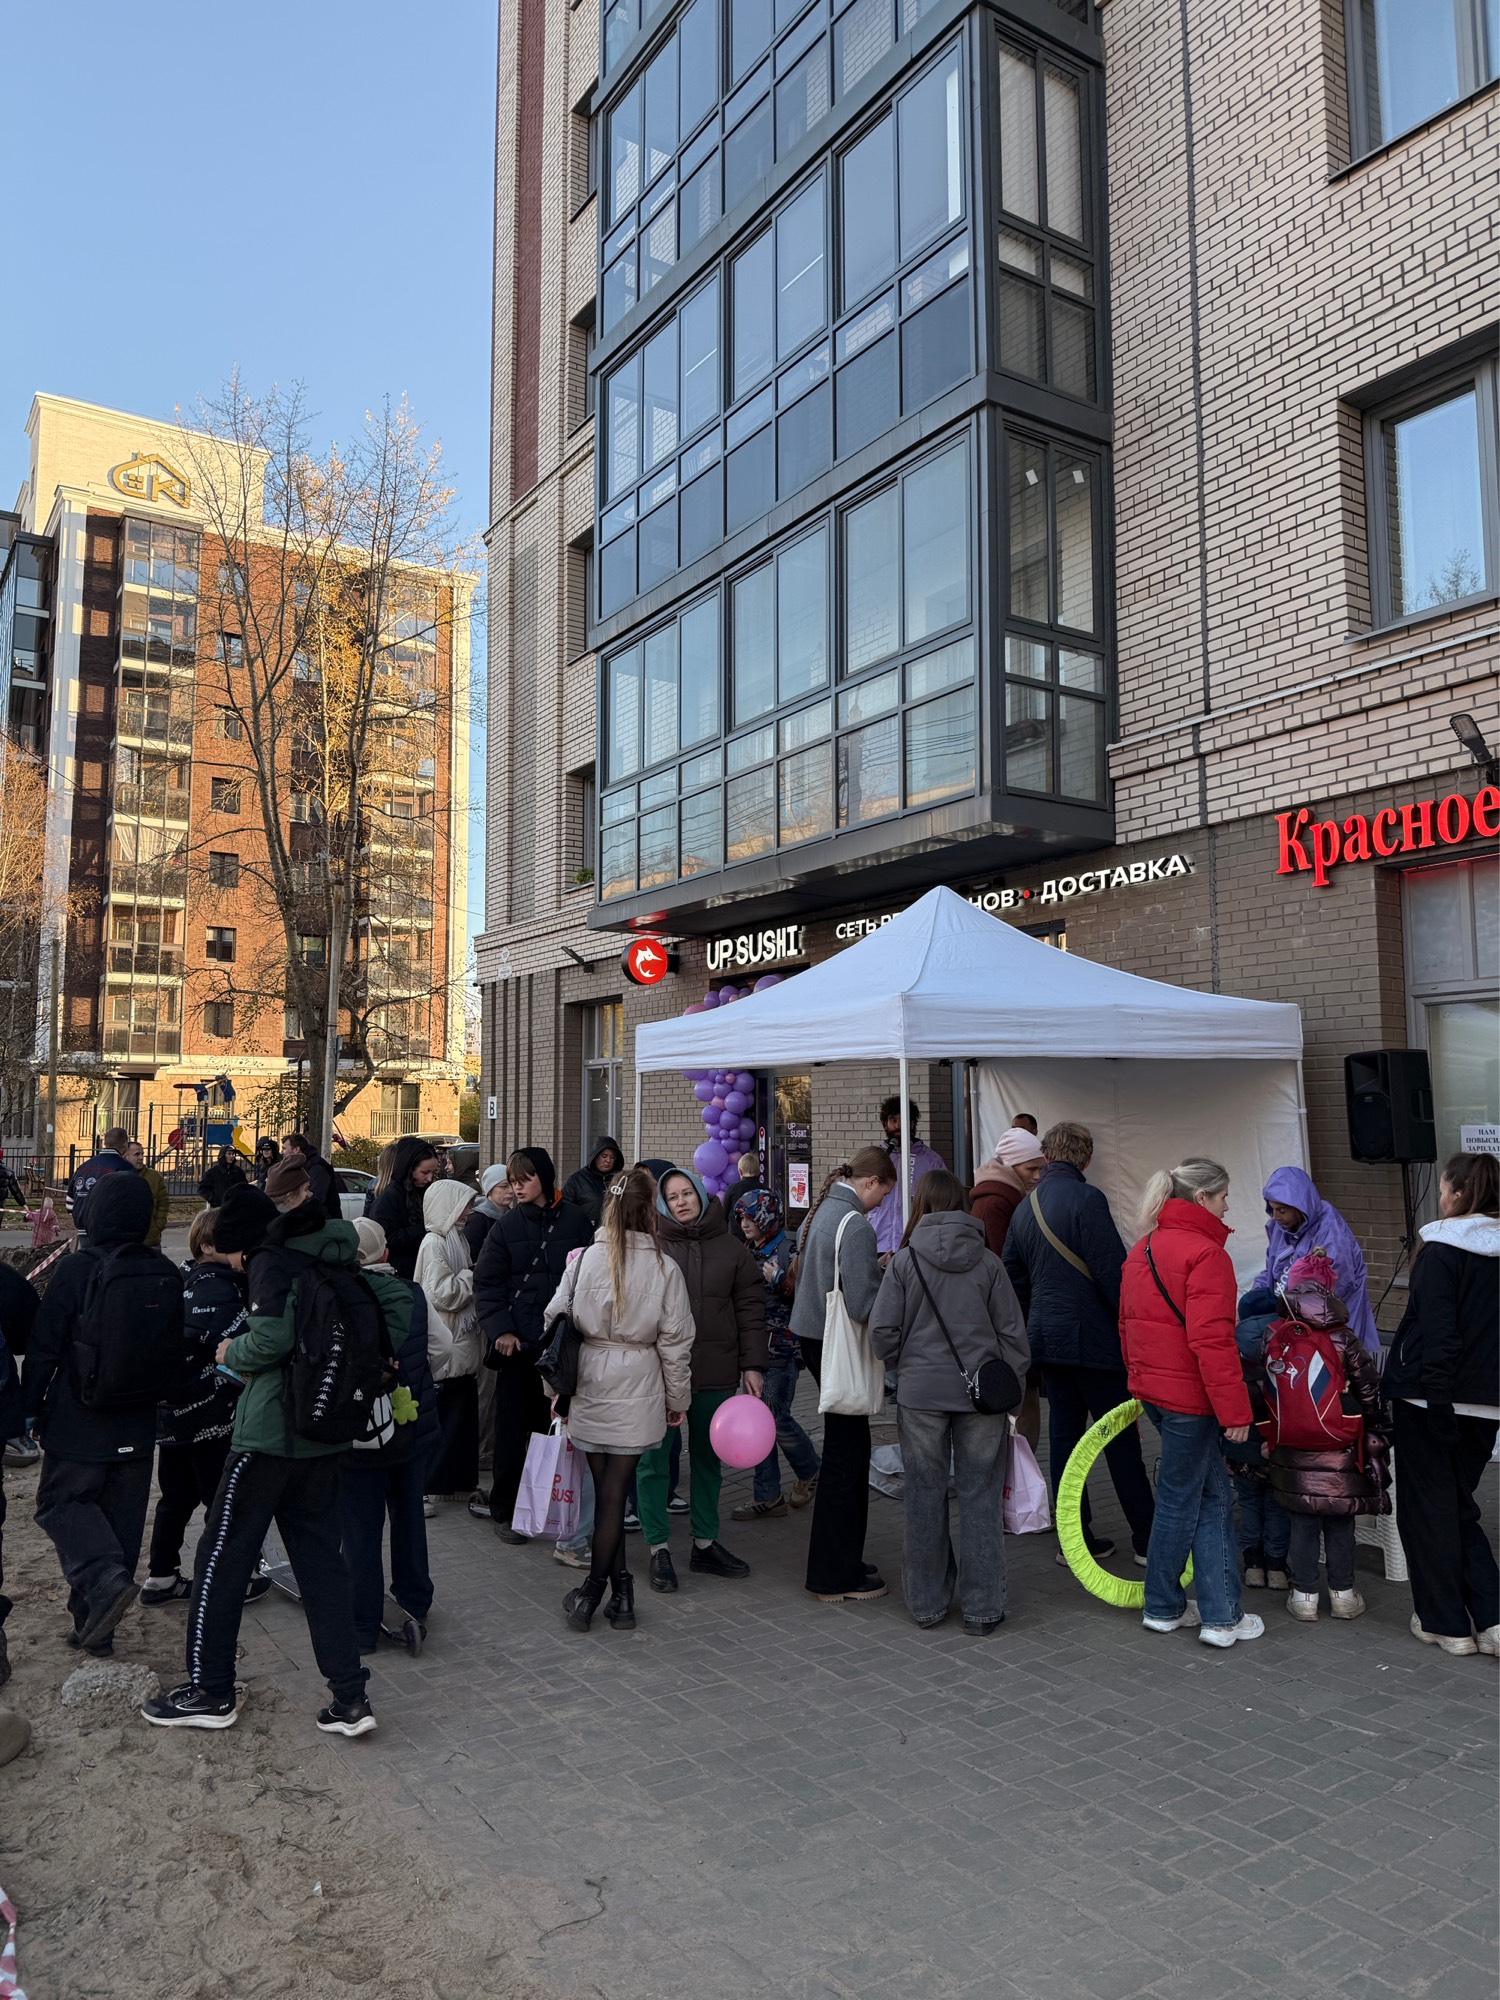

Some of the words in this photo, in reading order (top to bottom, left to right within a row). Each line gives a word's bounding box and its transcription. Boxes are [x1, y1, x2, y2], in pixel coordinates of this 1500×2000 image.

[1274, 786, 1500, 887] Красное
[836, 919, 877, 939] СЕТЬ
[1040, 854, 1187, 904] ДОСТАВКА
[706, 938, 733, 970] UP
[736, 925, 798, 965] SUSHI
